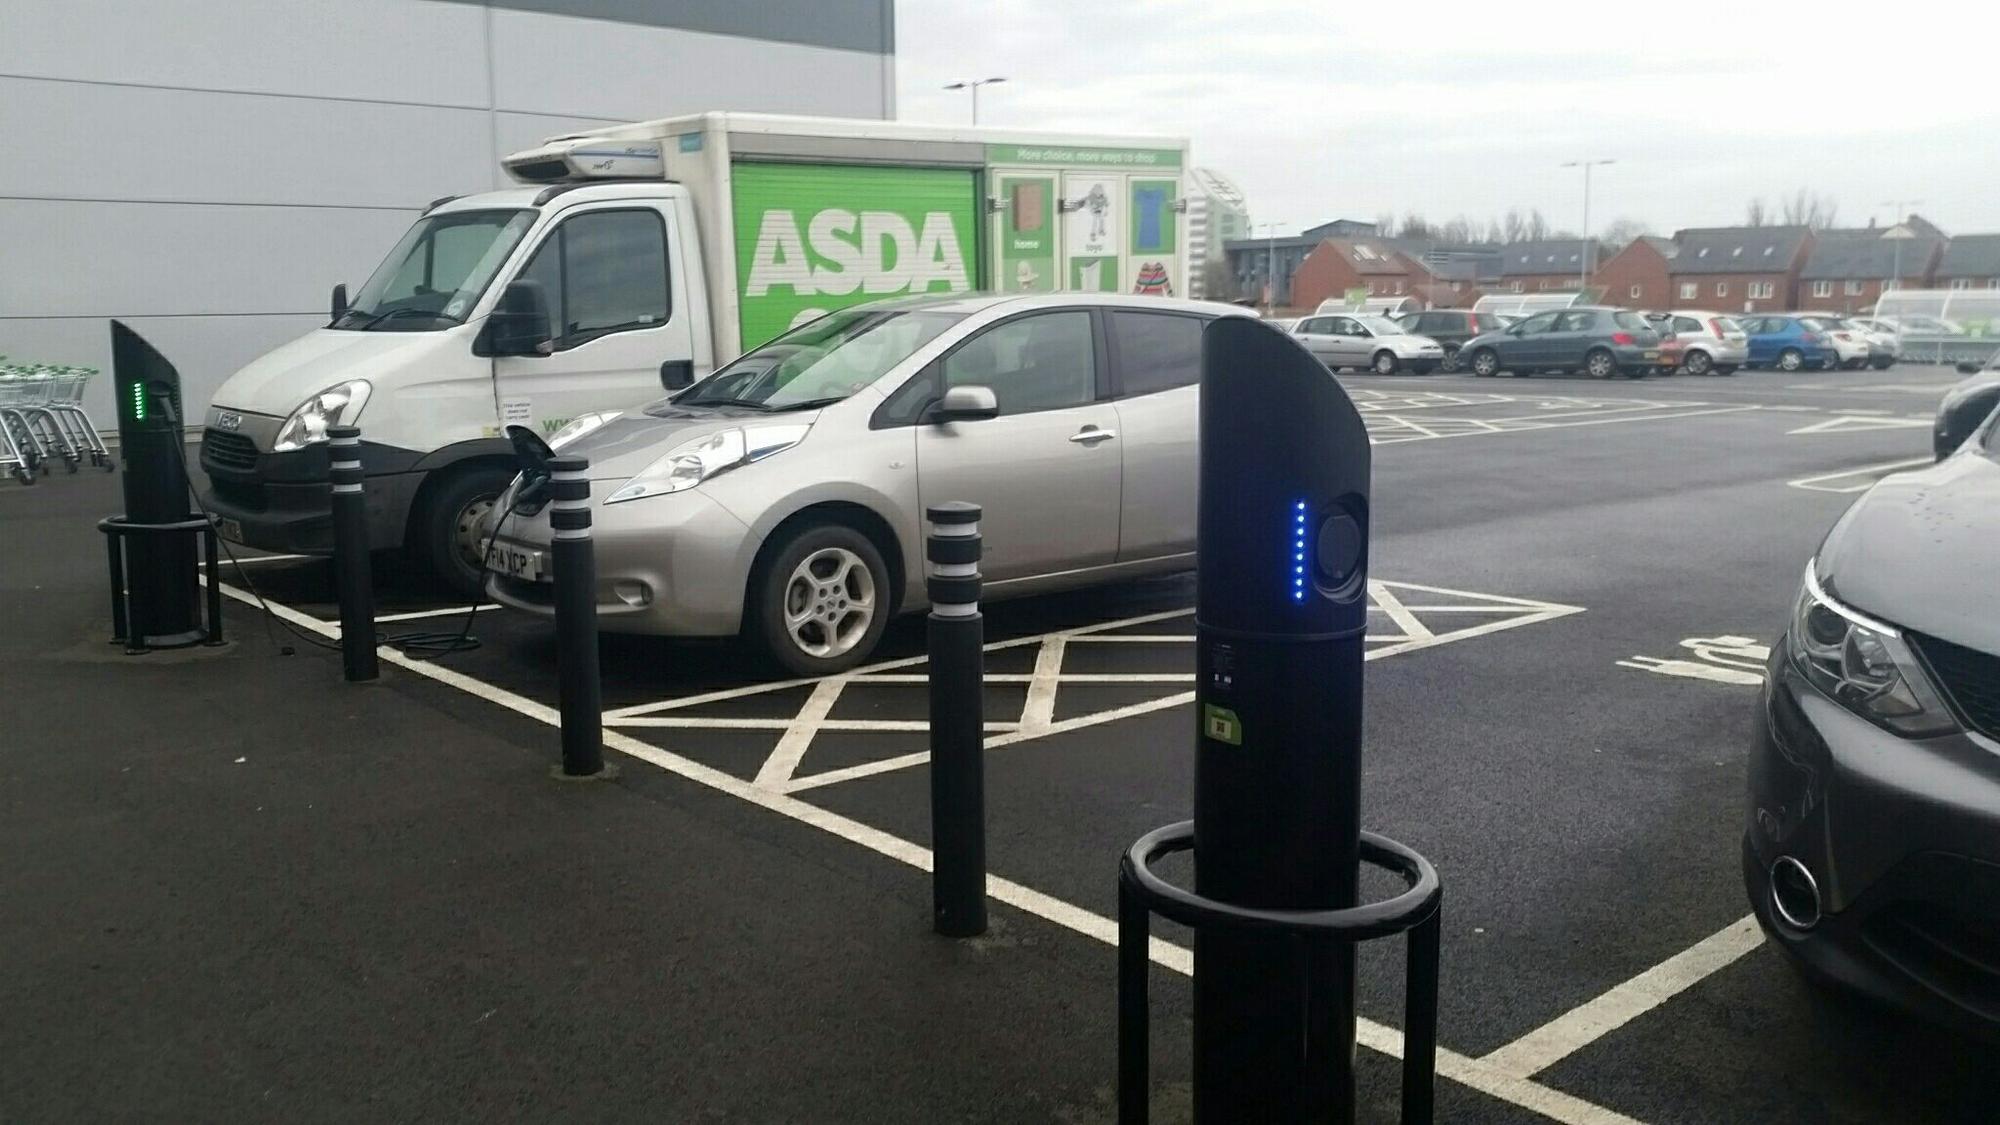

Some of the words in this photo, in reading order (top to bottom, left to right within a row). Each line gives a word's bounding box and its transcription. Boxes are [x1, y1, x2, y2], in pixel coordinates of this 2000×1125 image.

[1017, 149, 1042, 161] More
[1043, 150, 1074, 162] choice,
[1076, 152, 1100, 162] more
[745, 208, 971, 297] ASDA
[1014, 240, 1039, 250] home
[507, 549, 527, 575] XCP
